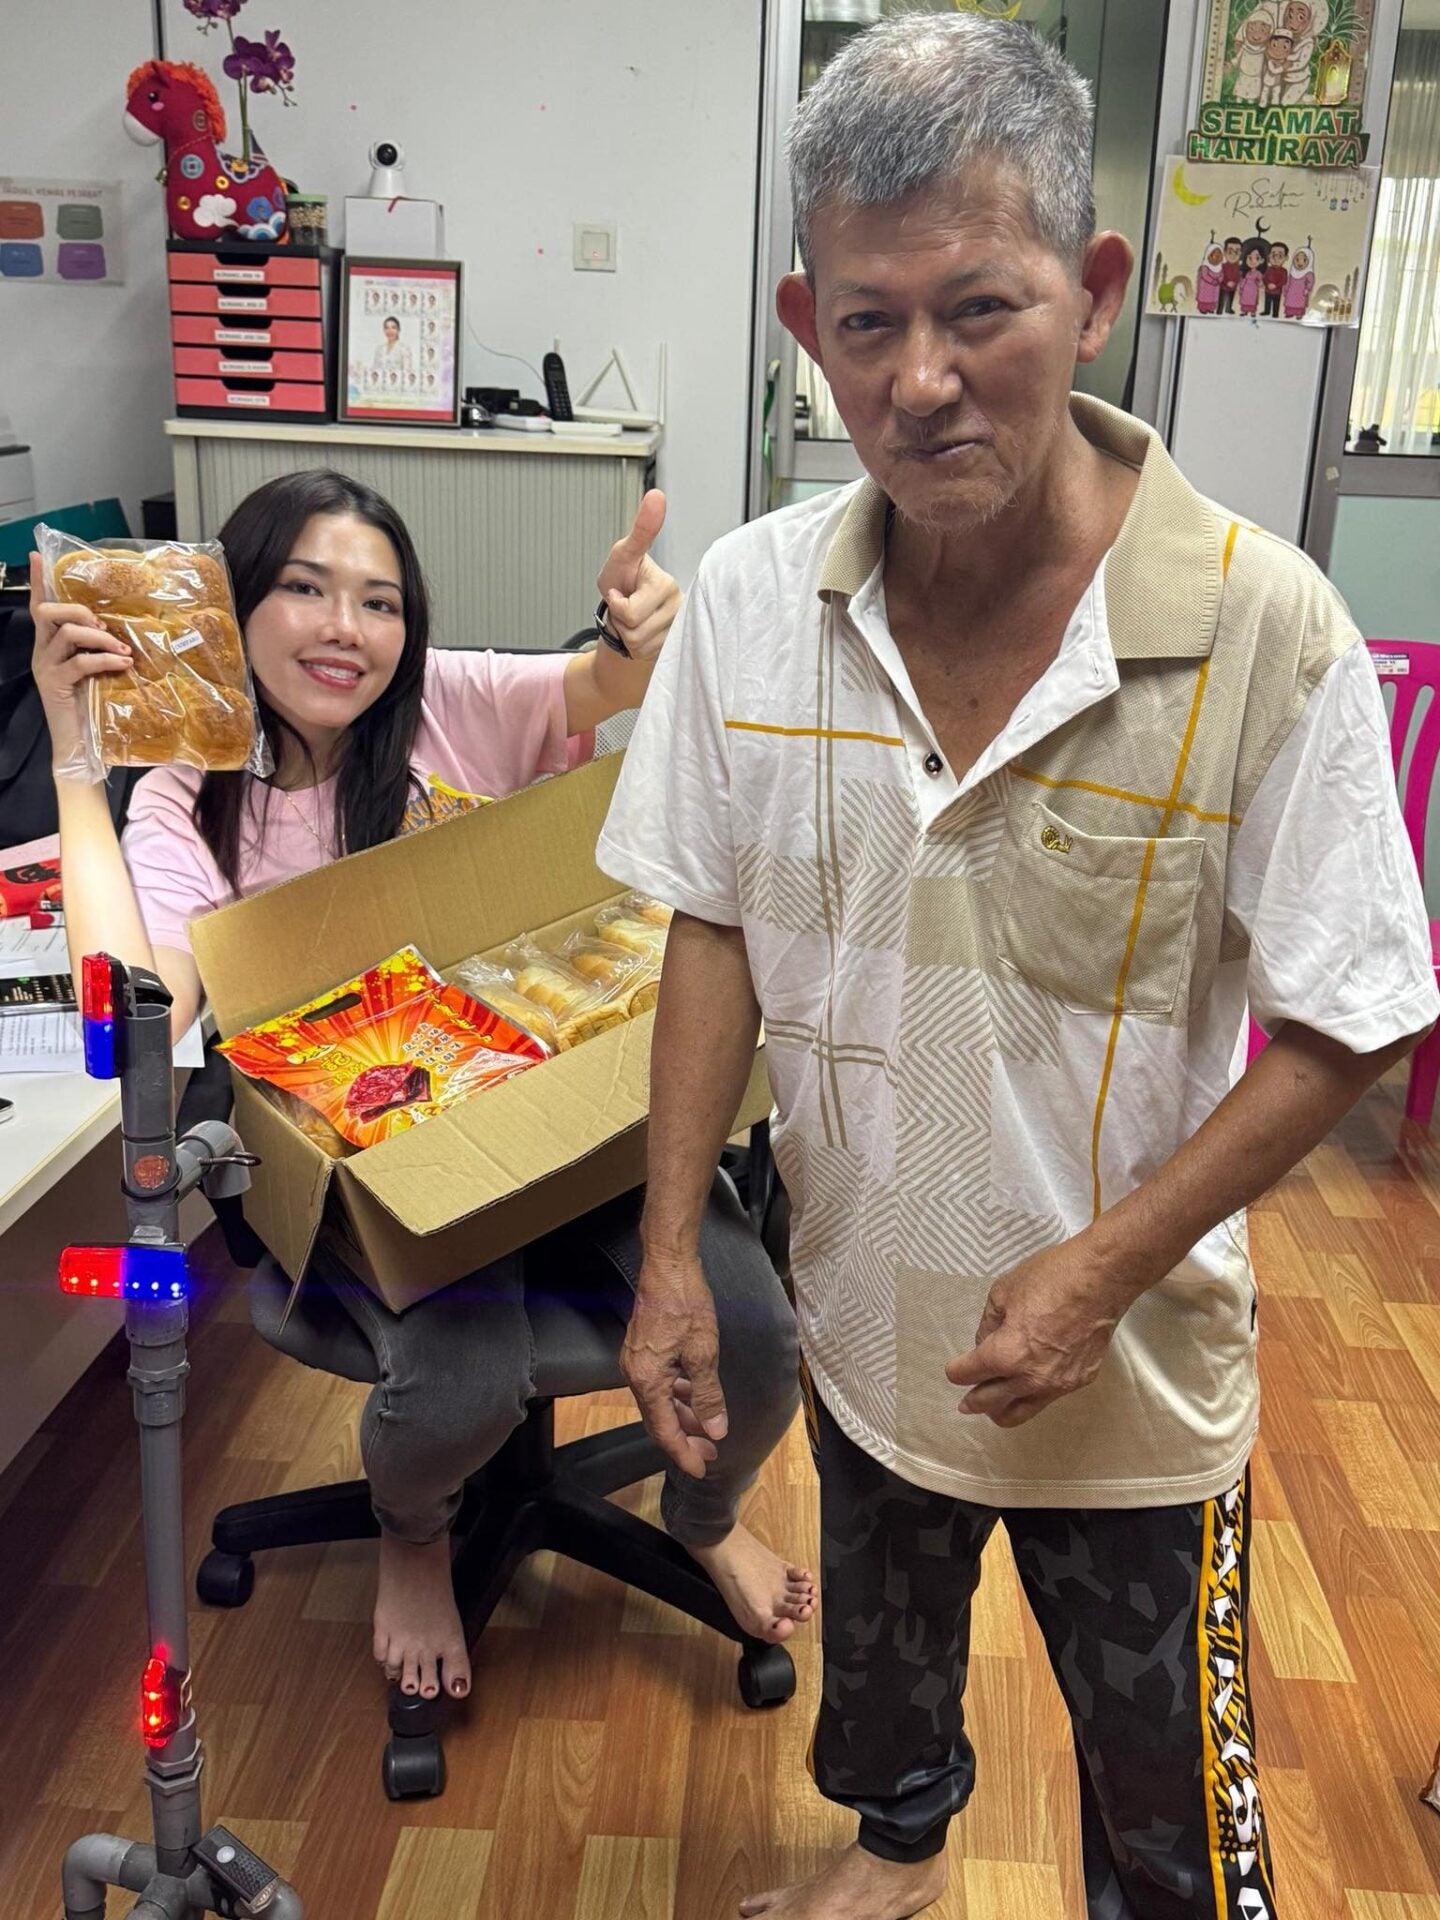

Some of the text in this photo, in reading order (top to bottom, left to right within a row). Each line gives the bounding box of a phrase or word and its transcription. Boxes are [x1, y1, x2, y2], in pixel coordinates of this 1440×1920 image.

[1202, 109, 1359, 136] SELAMAT
[1189, 133, 1360, 167] HARI RAYA
